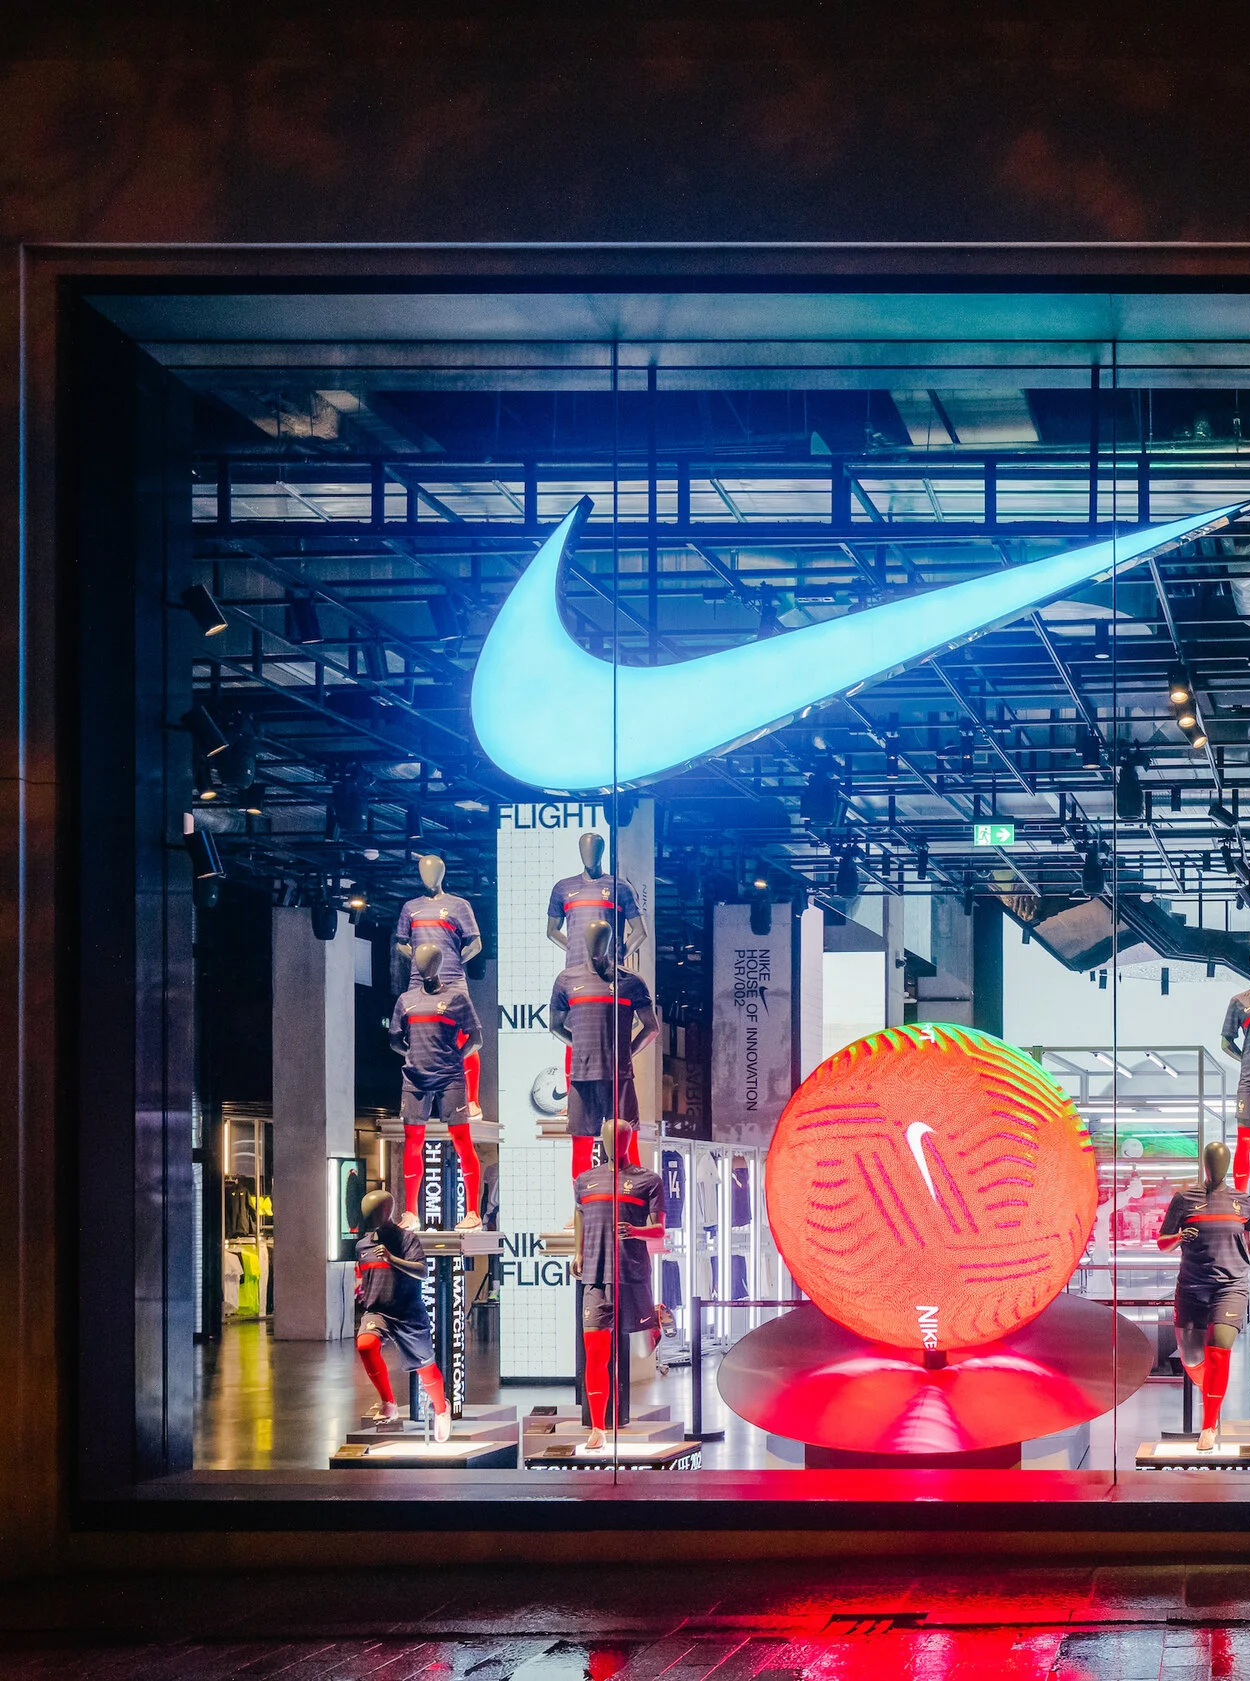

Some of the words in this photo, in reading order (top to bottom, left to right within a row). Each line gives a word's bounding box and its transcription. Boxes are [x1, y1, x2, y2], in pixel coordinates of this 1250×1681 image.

[498, 803, 603, 829] FLIGHT
[746, 949, 758, 998] HOUSE
[758, 949, 771, 982] NIKE
[498, 1004, 549, 1029] NIK
[746, 1004, 758, 1023] OF
[746, 1027, 758, 1112] INNOVATION
[425, 1168, 441, 1225] HOME
[453, 1275, 462, 1348] MATCH
[915, 1305, 939, 1350] NIKE
[453, 1353, 462, 1415] HOME
